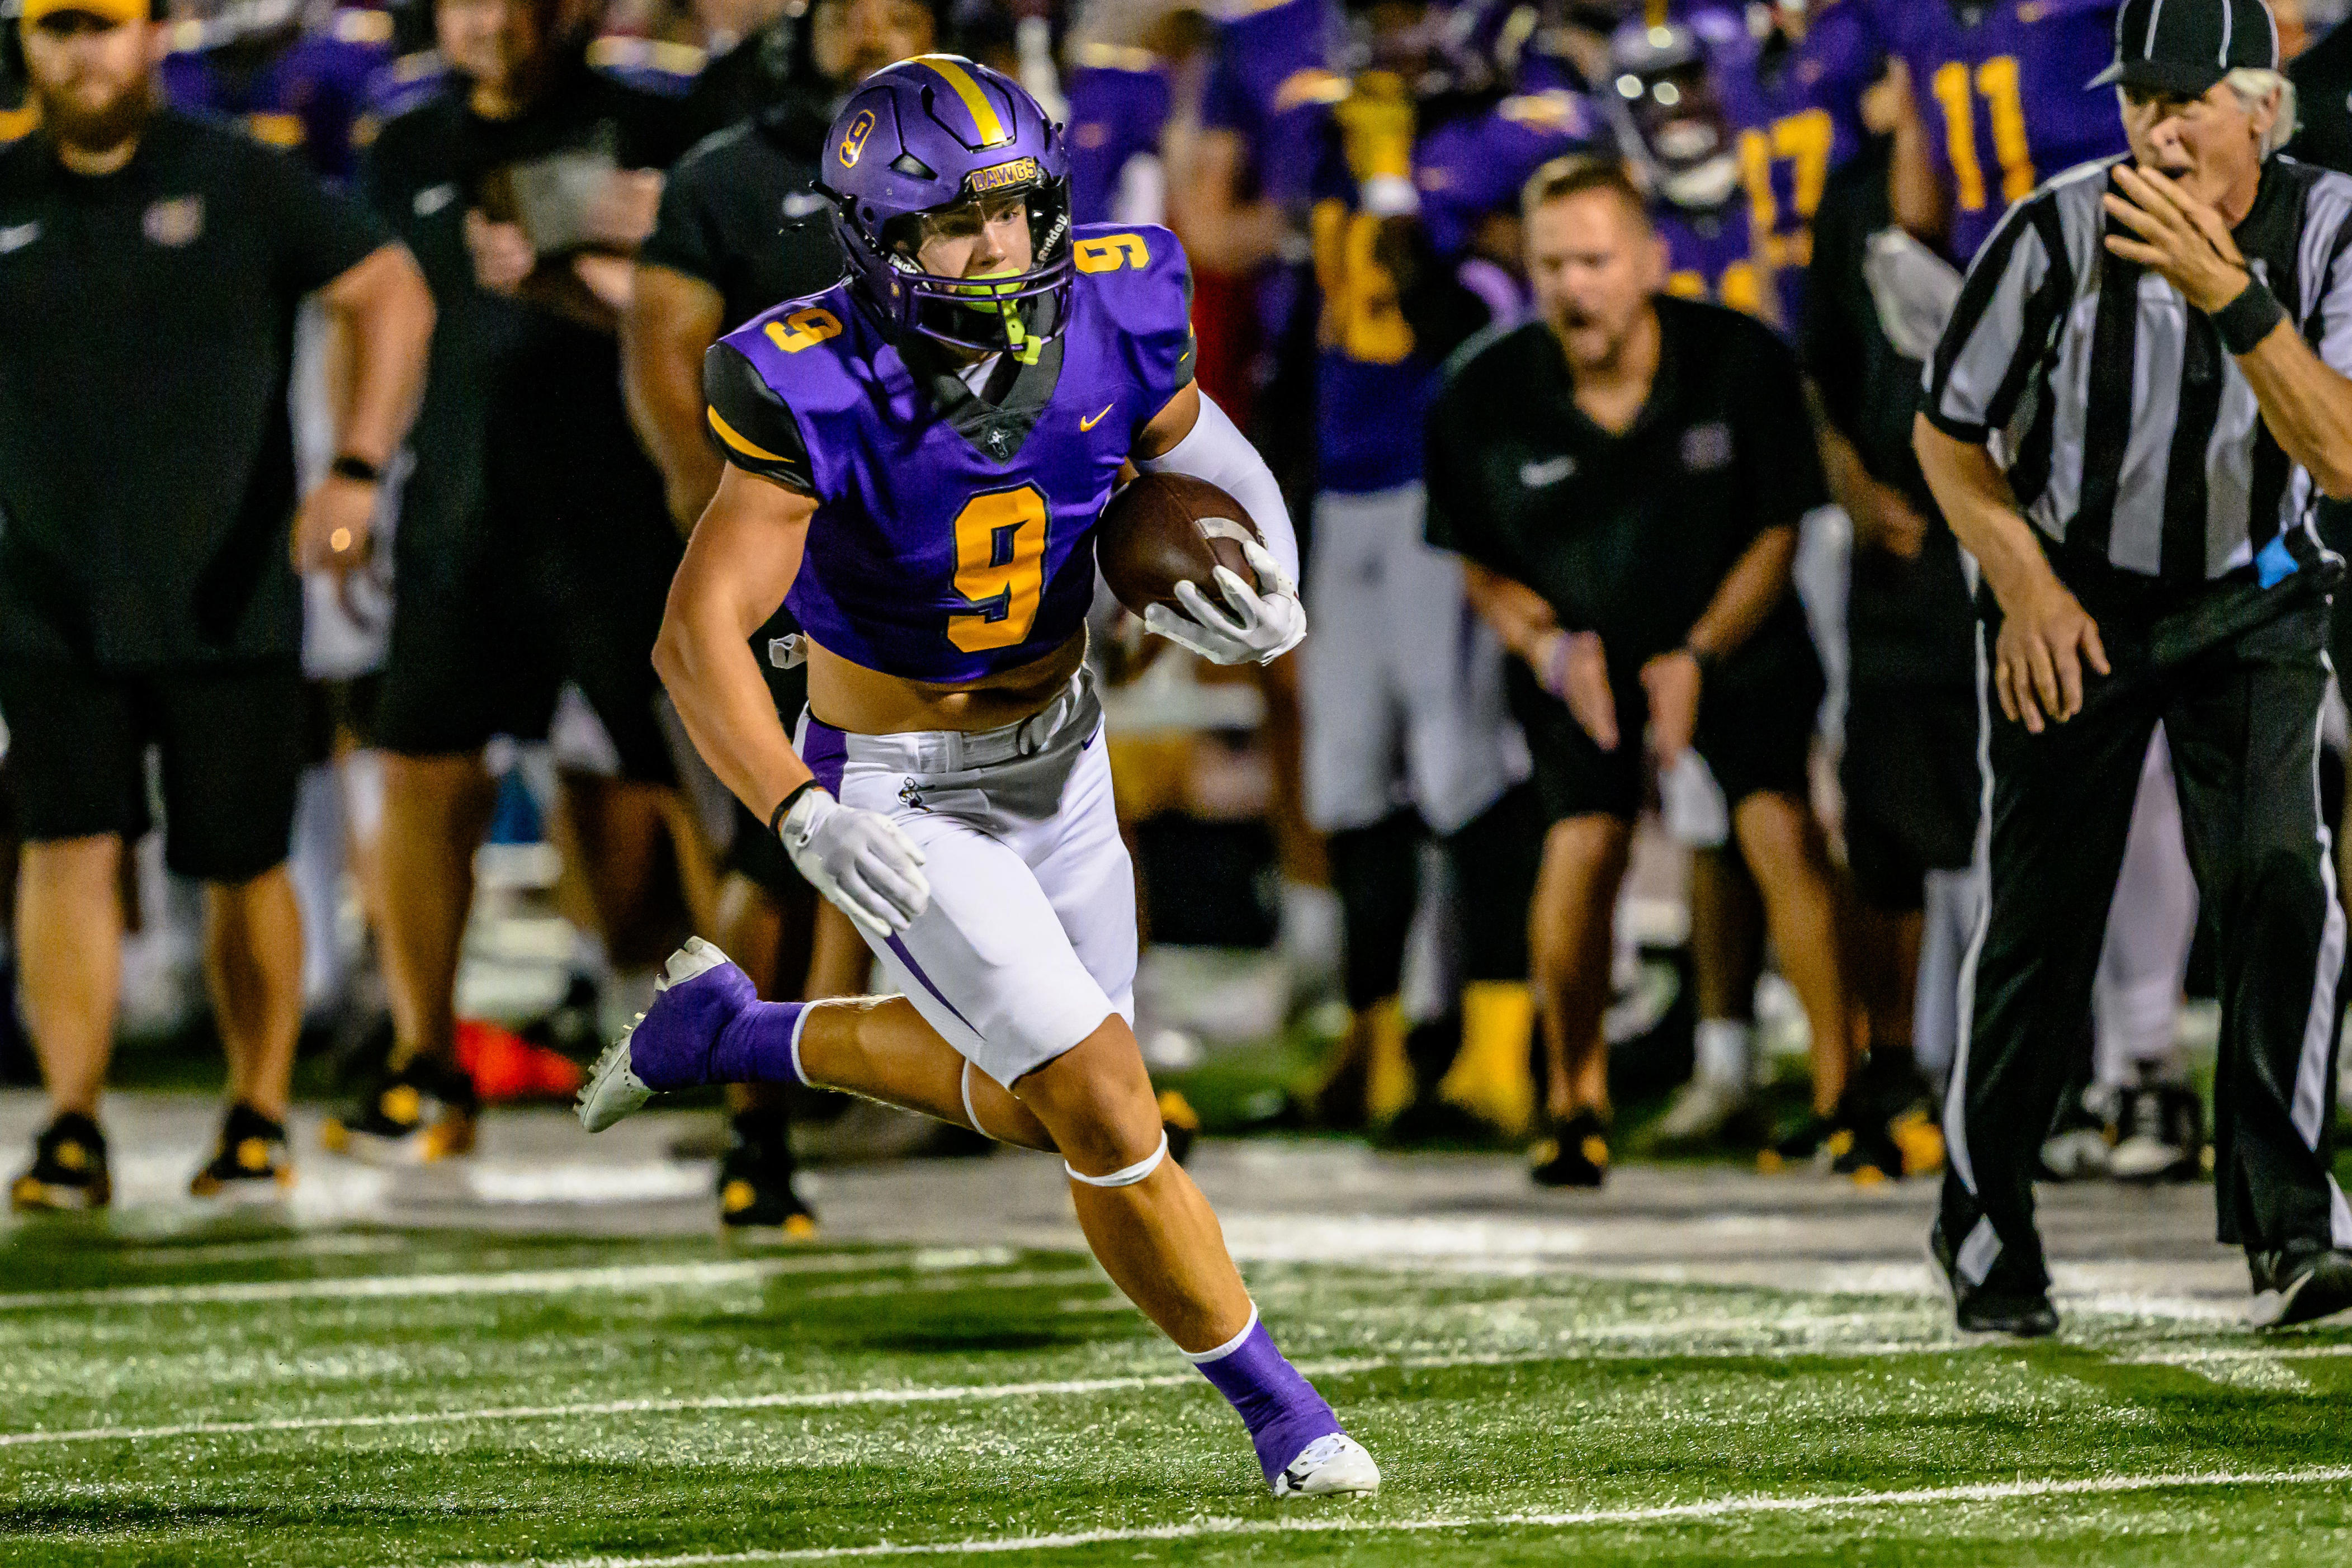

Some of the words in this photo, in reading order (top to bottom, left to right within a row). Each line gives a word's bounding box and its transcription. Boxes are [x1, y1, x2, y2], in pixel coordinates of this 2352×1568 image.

[839, 109, 876, 168] 9
[1933, 56, 2036, 212] 11
[971, 158, 1037, 192] DAWGS
[1037, 213, 1069, 262] Riddell
[1073, 233, 1151, 275] 9
[763, 308, 843, 354] 9
[947, 479, 1051, 654] 9
